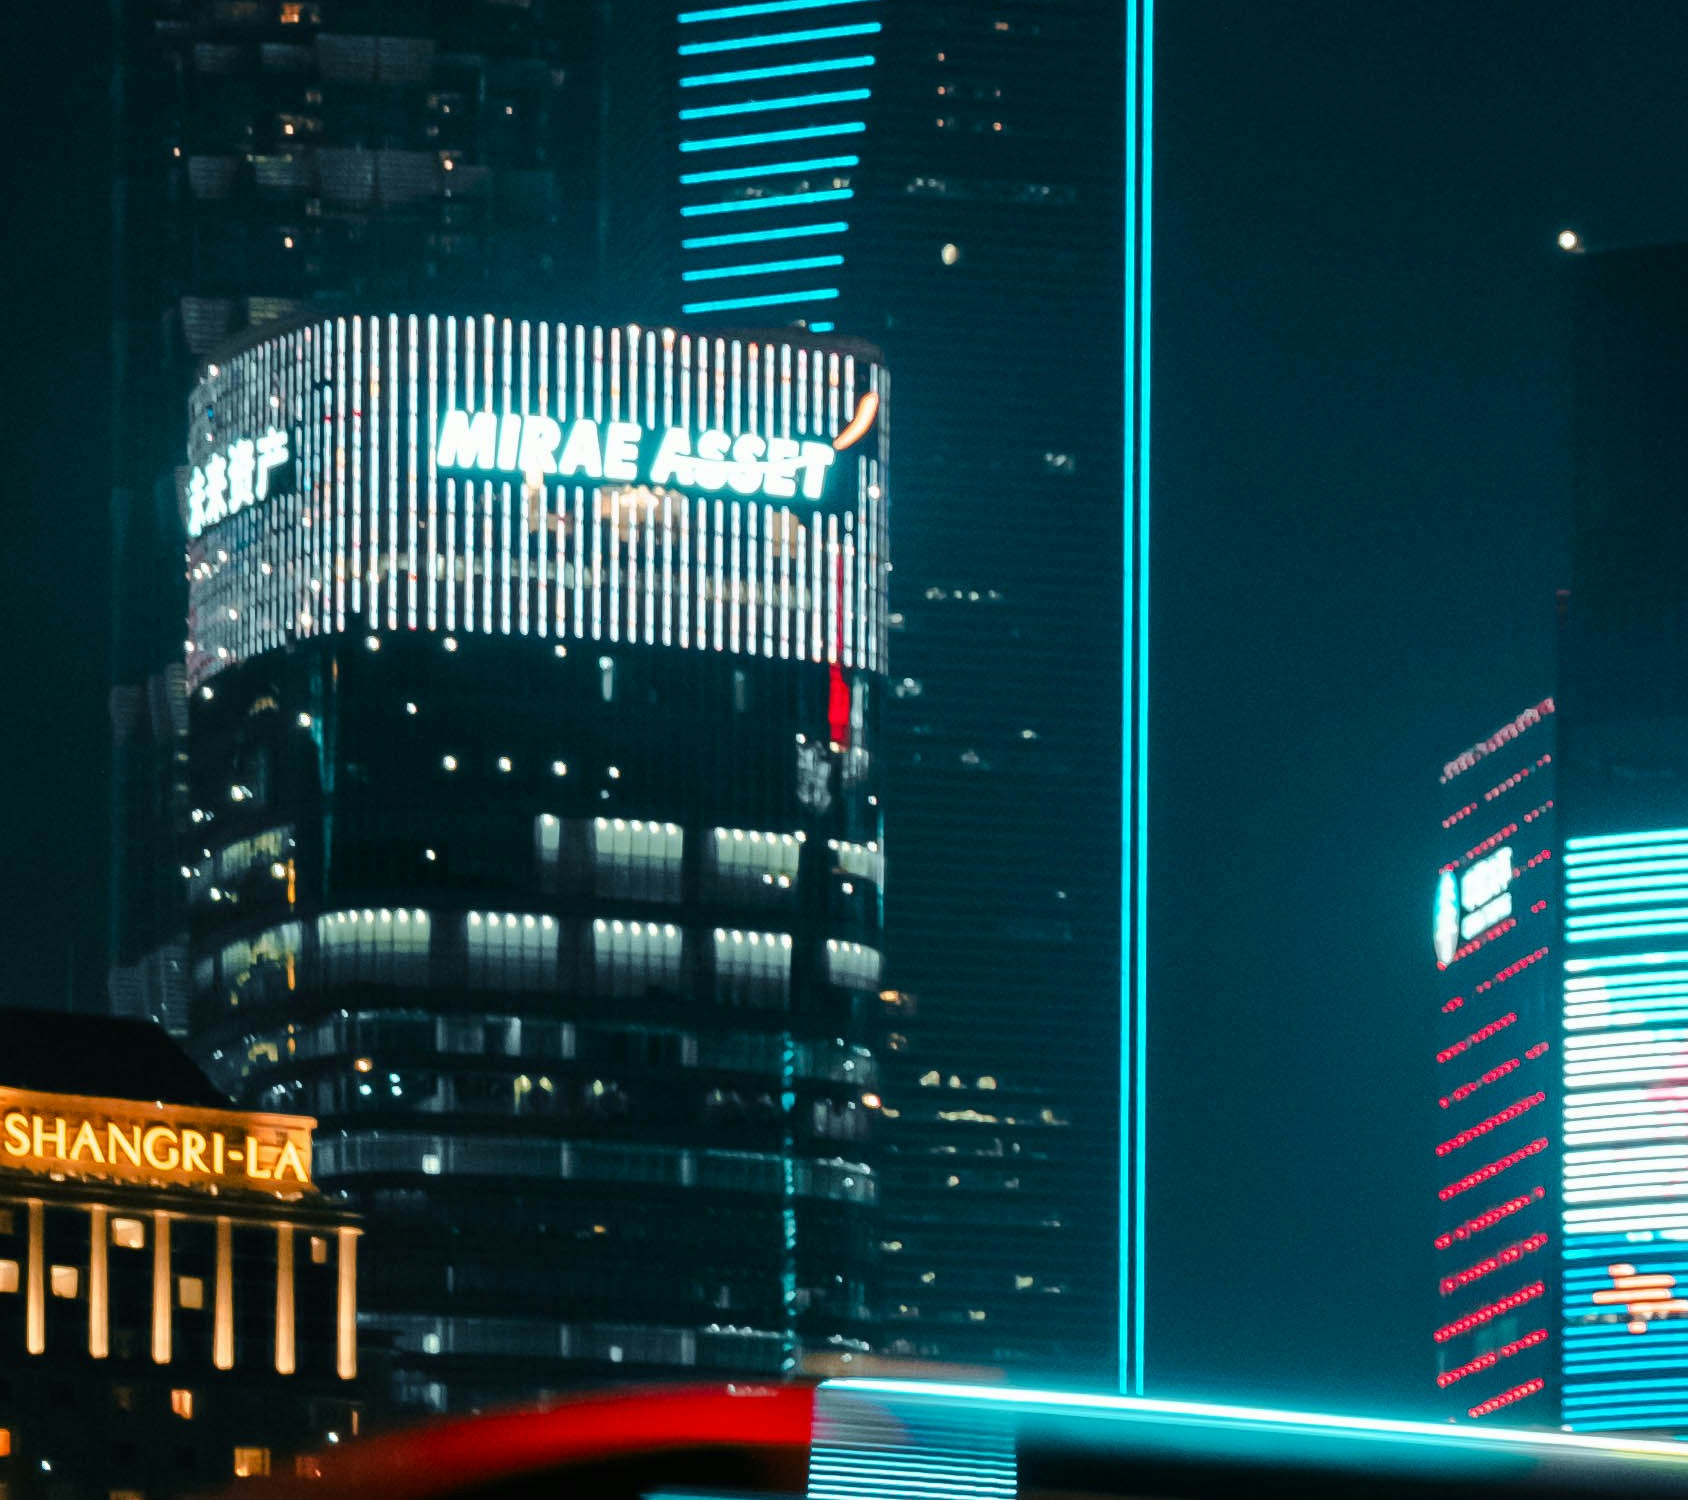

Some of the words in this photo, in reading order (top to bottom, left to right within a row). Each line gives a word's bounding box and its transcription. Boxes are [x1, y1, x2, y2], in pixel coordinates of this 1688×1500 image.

[437, 409, 641, 480] MIRAE
[650, 426, 835, 500] ASSET
[4, 1112, 309, 1183] SHANGRI-LA
